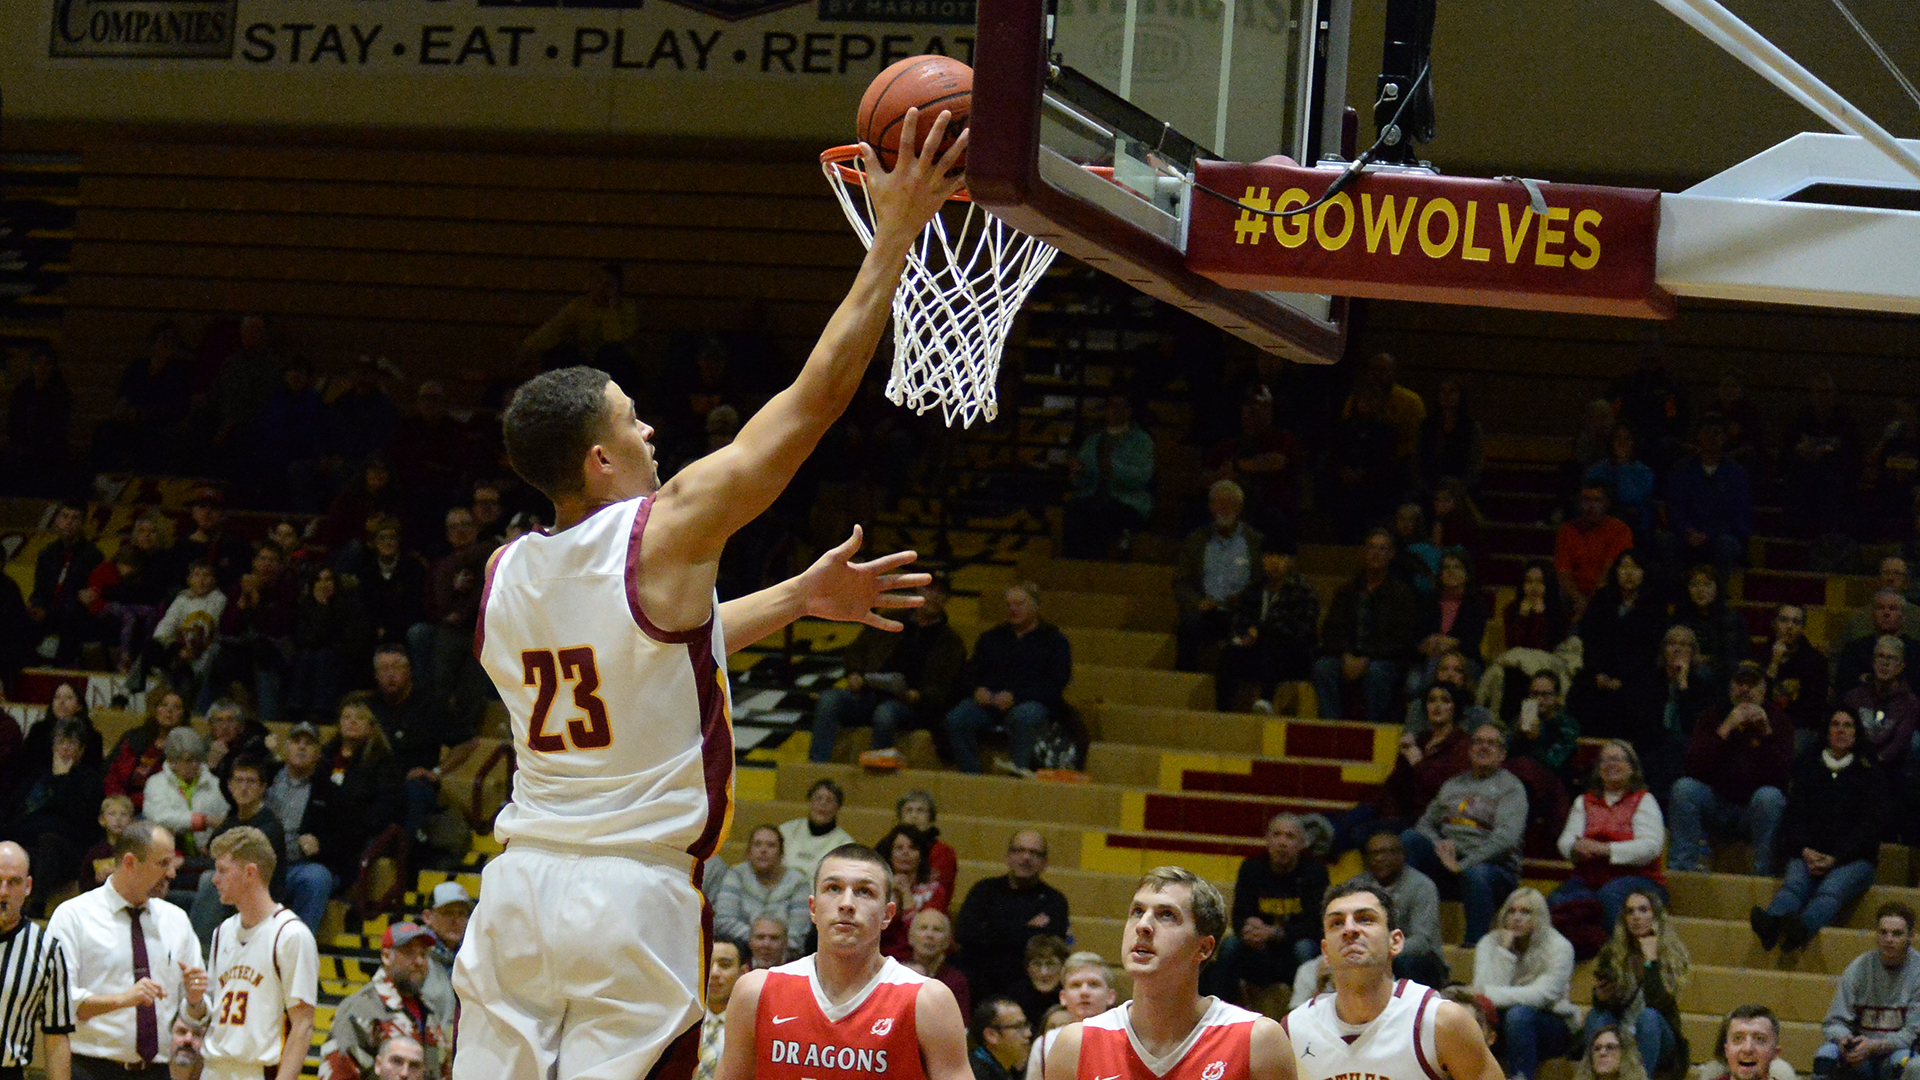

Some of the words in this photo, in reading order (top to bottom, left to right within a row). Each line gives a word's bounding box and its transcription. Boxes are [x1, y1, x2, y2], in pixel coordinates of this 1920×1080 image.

[242, 23, 382, 63] STAY
[419, 25, 535, 66] EAT
[572, 26, 722, 70] PLAY
[1234, 186, 1603, 270] #GOWOLVES
[521, 644, 614, 754] 23
[219, 990, 249, 1026] 33
[771, 1039, 888, 1073] DRAGONS
